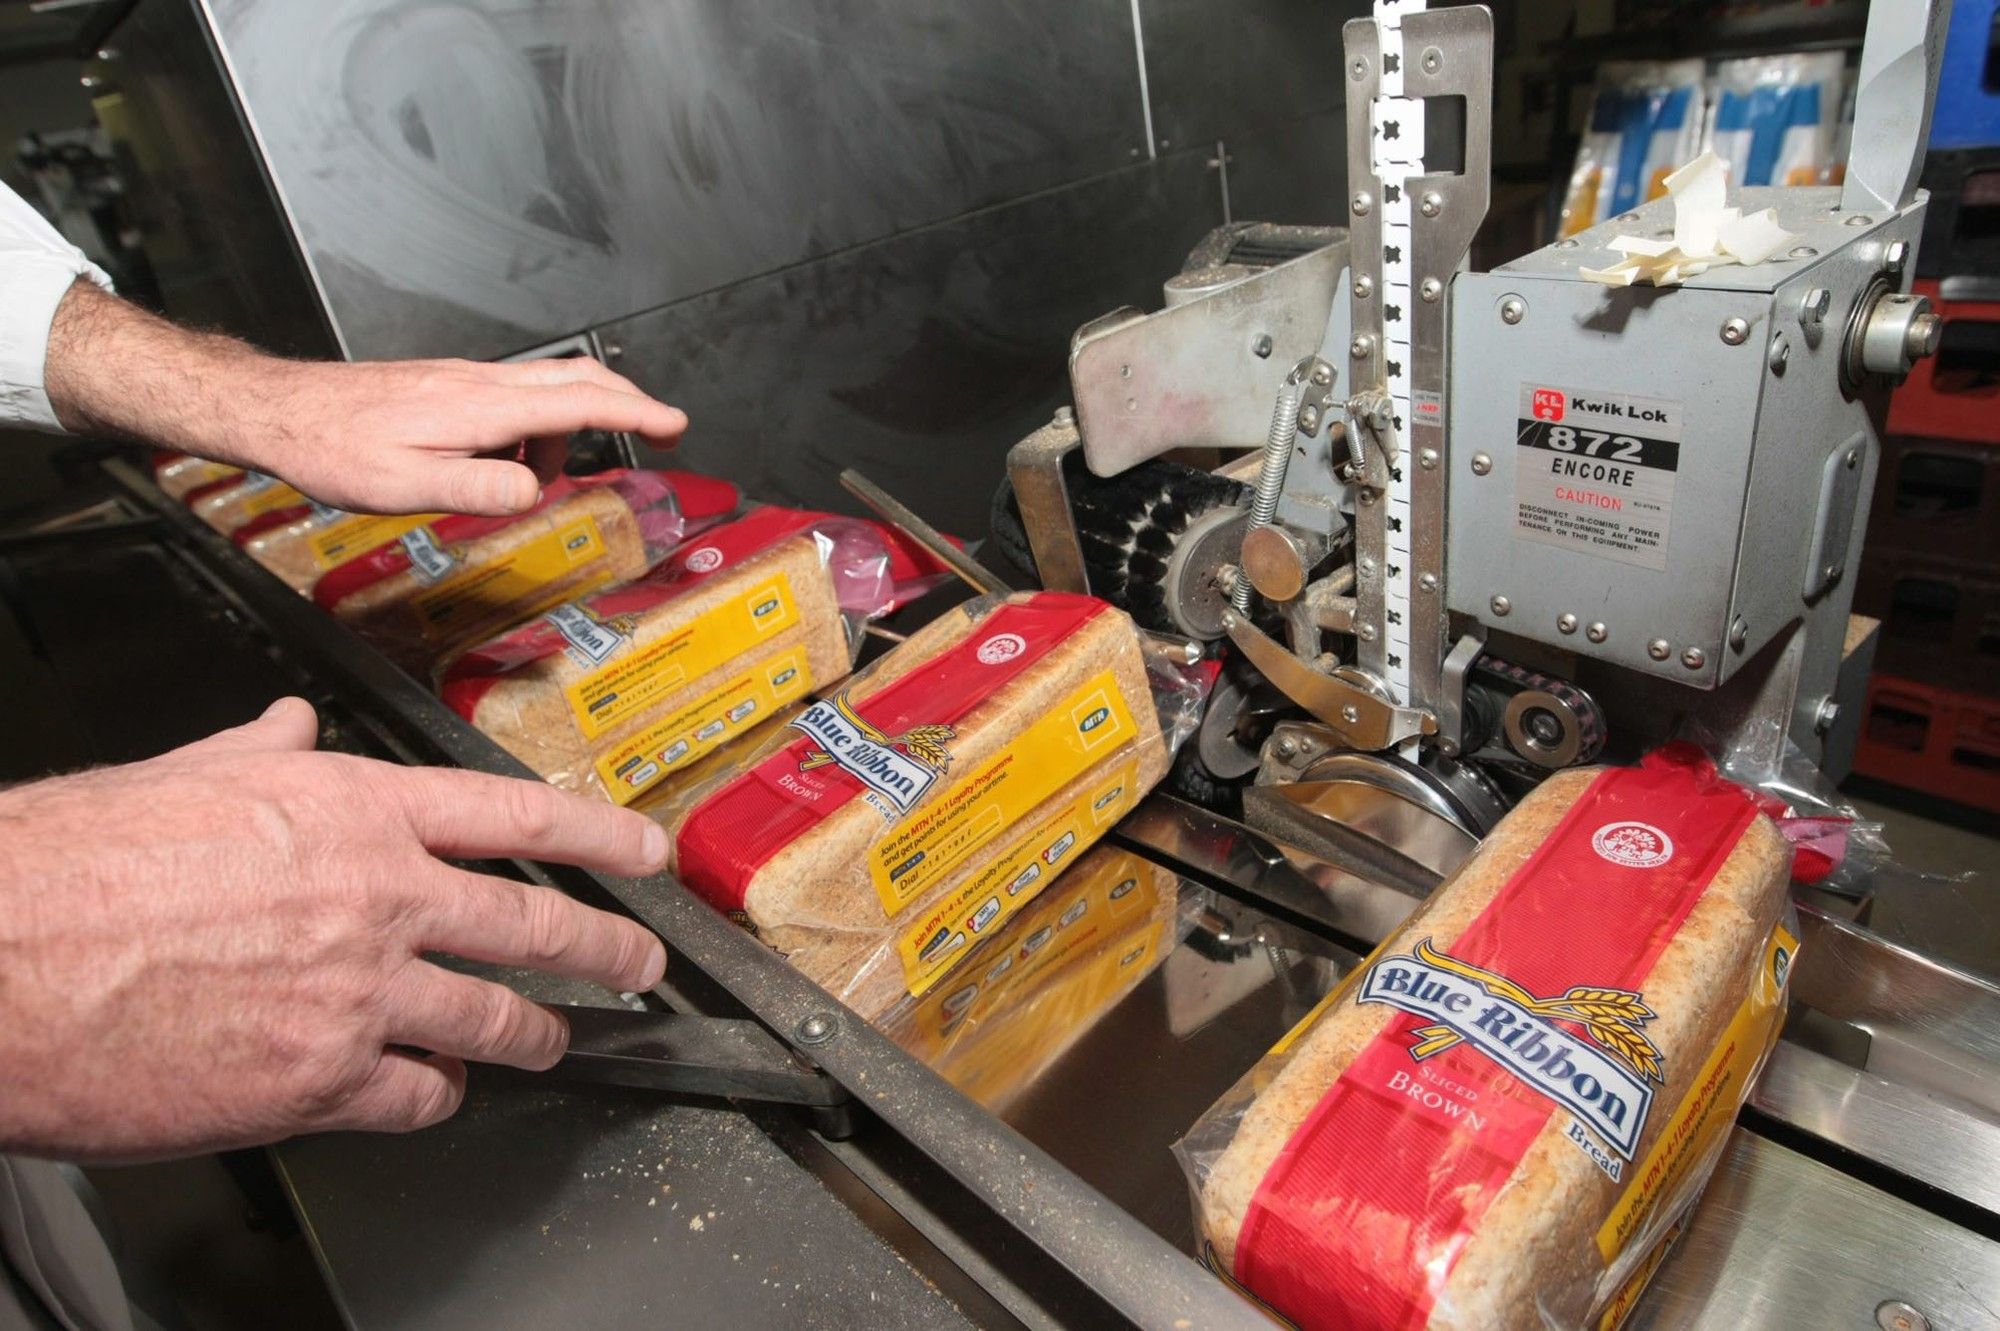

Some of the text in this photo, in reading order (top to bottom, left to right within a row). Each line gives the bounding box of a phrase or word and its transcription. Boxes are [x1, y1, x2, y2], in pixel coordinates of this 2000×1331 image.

[1535, 392, 1562, 408] KL
[1571, 398, 1668, 423] Kwik Lok
[1548, 426, 1643, 463] 872
[1552, 458, 1634, 486] ENCORE
[1555, 487, 1622, 511] CAUTION
[1519, 503, 1660, 539] DISCONNECT IN-COMING POWER
[1519, 511, 1659, 547] BEFORE PERFORMING ANY MAIN-
[1519, 520, 1551, 532] TENANCE
[1556, 529, 1567, 537] ON
[1572, 532, 1588, 541] THIS
[1085, 709, 1105, 731] MTN
[802, 706, 915, 798] Blue Ribbon
[777, 774, 823, 801] BROWN
[866, 793, 897, 824] Bread
[880, 843, 897, 858] Join
[897, 832, 911, 844] the
[910, 819, 930, 836] MTN
[930, 803, 949, 821] 1-4-1
[949, 785, 974, 808] Loyalty
[973, 754, 1014, 789] Programme
[883, 853, 900, 868] and
[900, 844, 914, 860] get
[914, 828, 937, 850] points
[936, 818, 948, 832] for
[947, 804, 967, 822] using
[966, 791, 983, 807] your
[900, 870, 920, 891] Dial
[914, 931, 928, 950] Join
[926, 916, 941, 933] MTN
[962, 887, 974, 900] the
[974, 866, 997, 889] Loyalty
[1380, 966, 1629, 1132] Blue Ribbon
[1386, 1070, 1486, 1131] BROWN
[1418, 1065, 1478, 1102] SLICED
[1568, 1122, 1621, 1180] Bread
[1616, 1211, 1633, 1242] Join
[1631, 1192, 1645, 1213] the
[1642, 1160, 1662, 1198] MTN
[1661, 1131, 1680, 1166] 1-4-1
[1678, 1096, 1701, 1139] Loyalty
